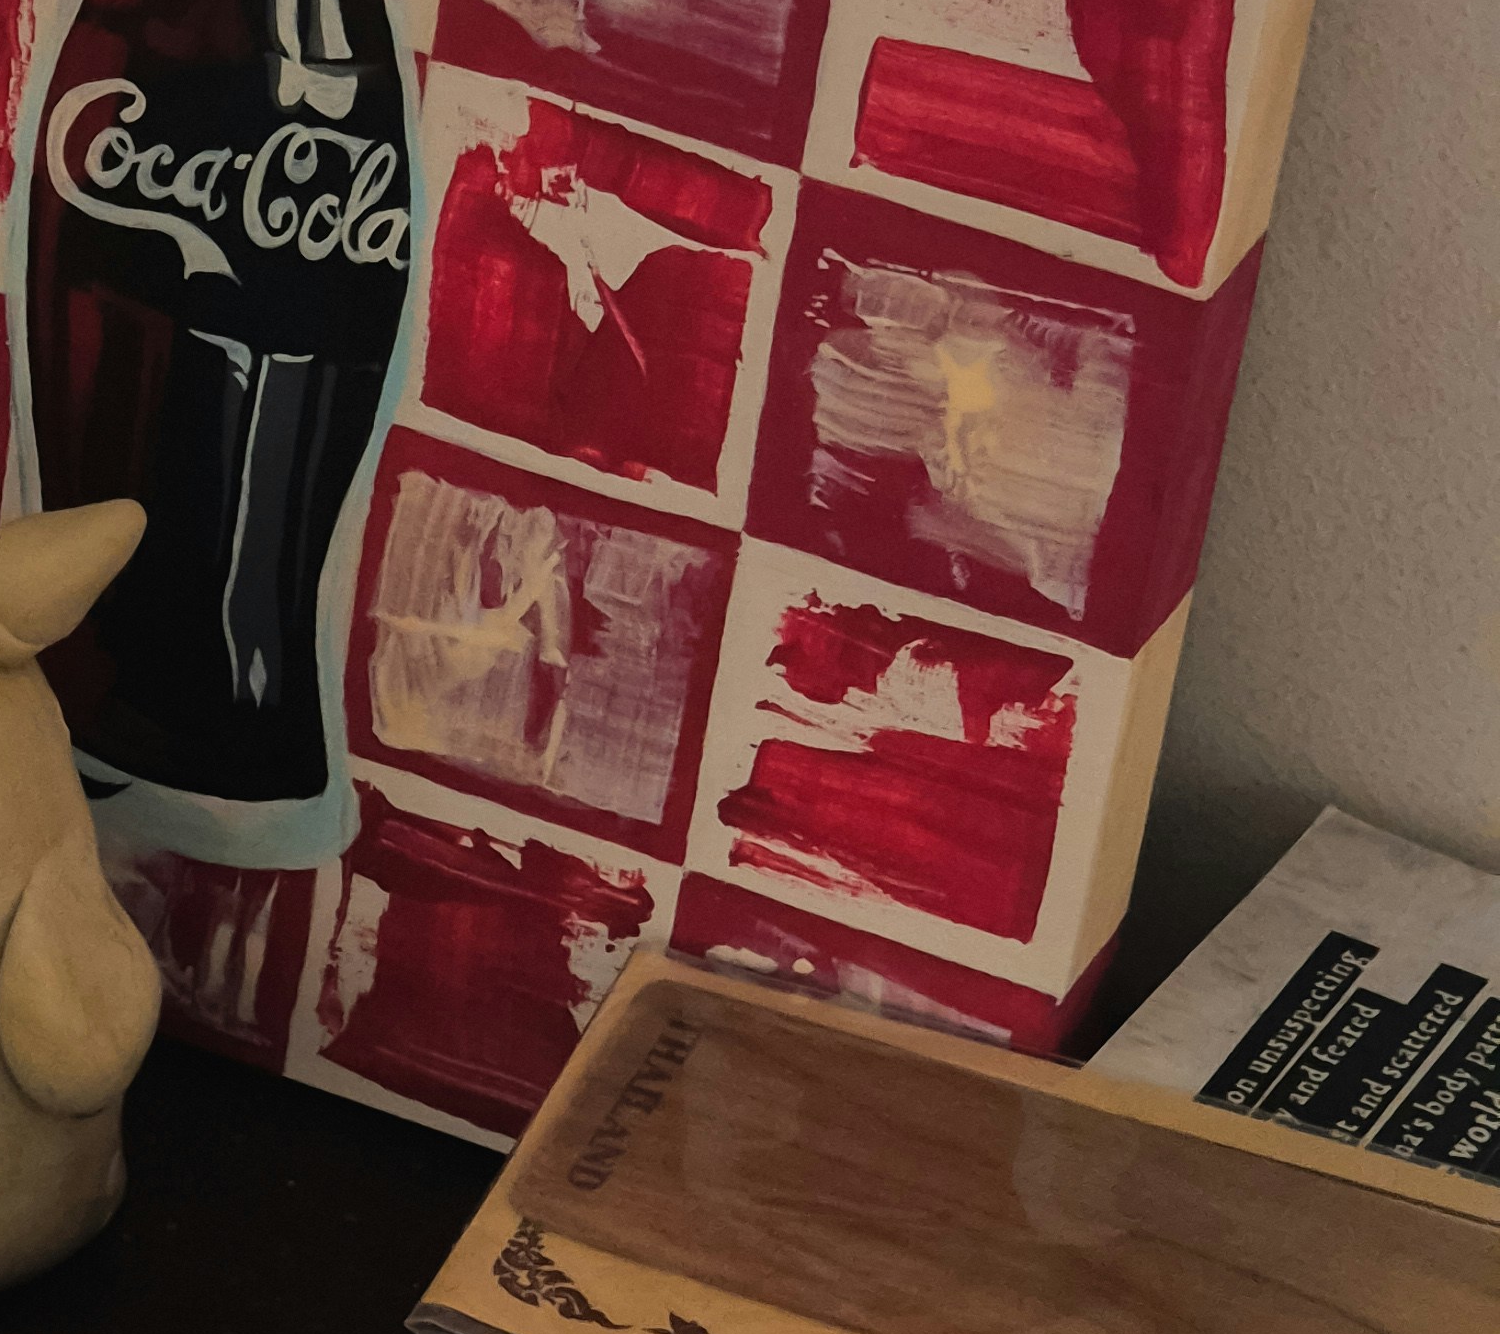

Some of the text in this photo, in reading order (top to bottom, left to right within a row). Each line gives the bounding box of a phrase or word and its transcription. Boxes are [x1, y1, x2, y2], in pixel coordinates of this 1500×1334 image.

[46, 77, 411, 286] Coca-Cola
[1226, 948, 1371, 1105] on unsuspecting
[1288, 1064, 1331, 1106] and
[1310, 1001, 1382, 1066] feared
[1351, 1077, 1393, 1120] and
[1380, 989, 1464, 1079] scattered
[1412, 1067, 1481, 1116] body
[1464, 1012, 1500, 1072] part
